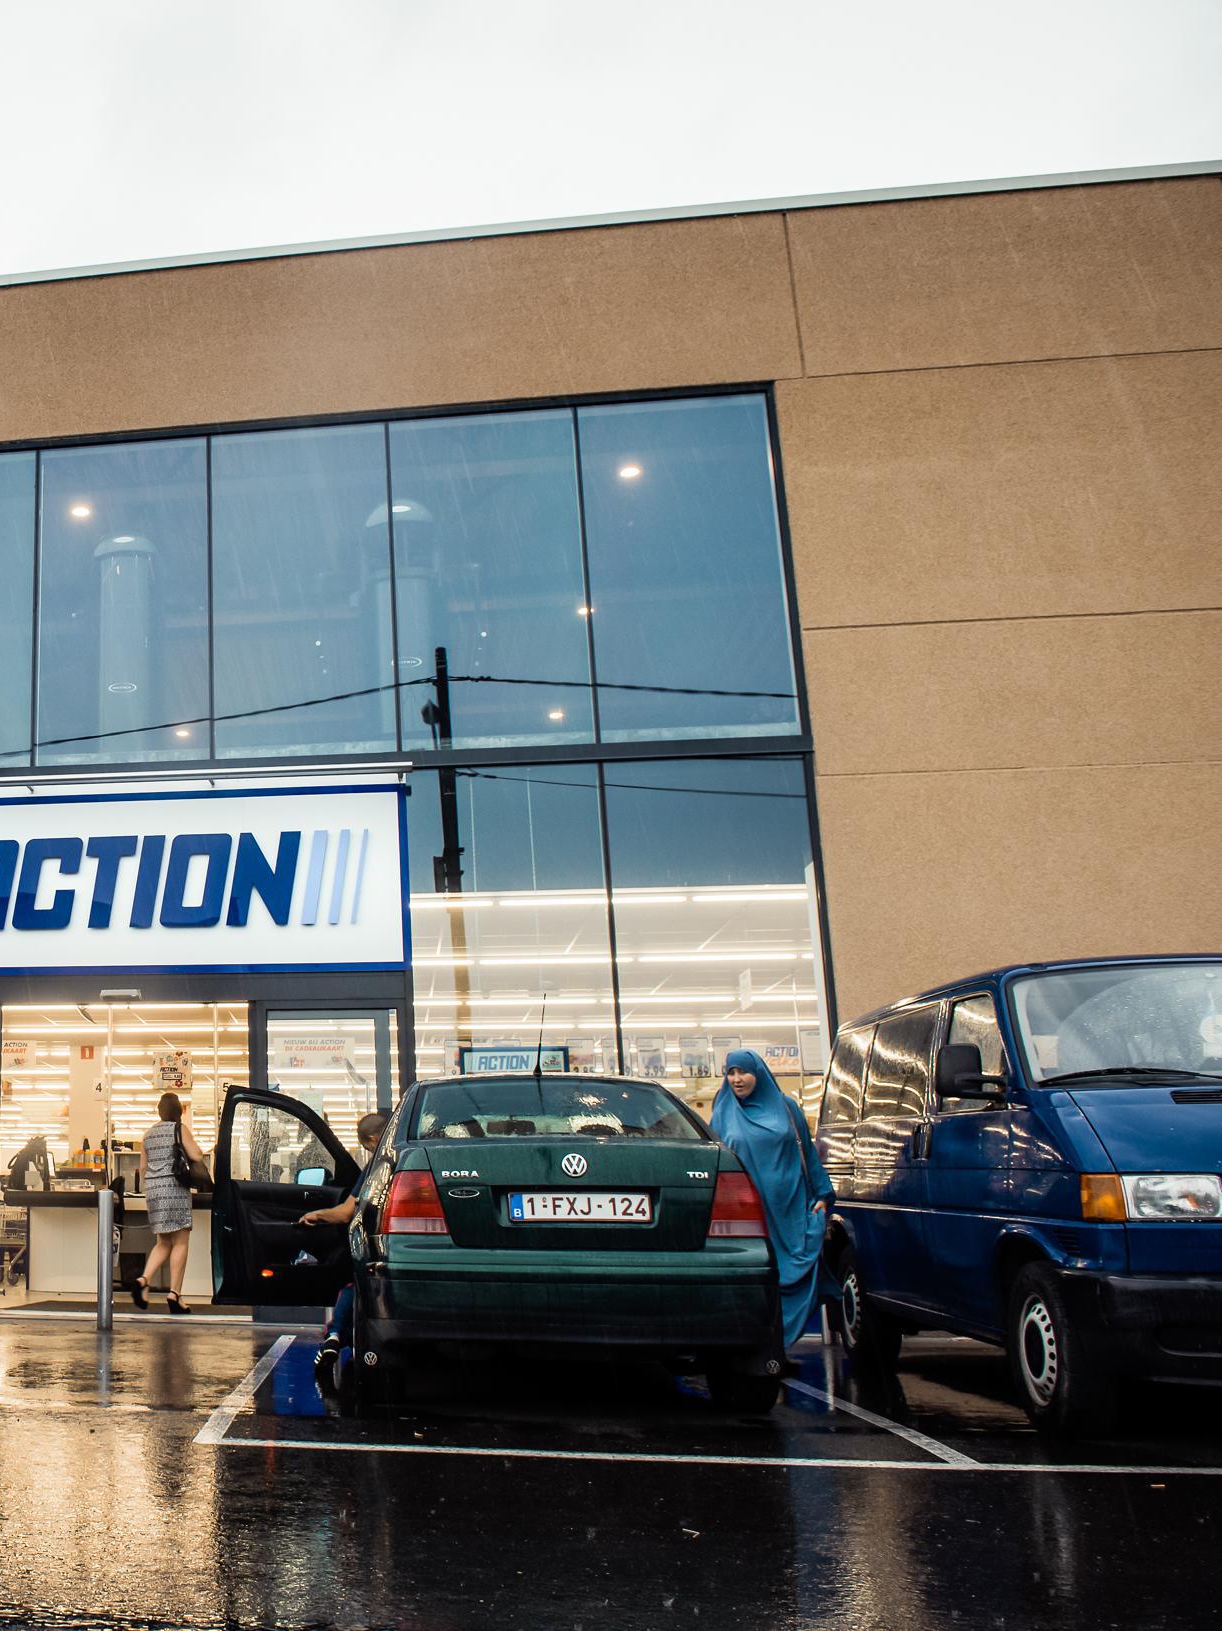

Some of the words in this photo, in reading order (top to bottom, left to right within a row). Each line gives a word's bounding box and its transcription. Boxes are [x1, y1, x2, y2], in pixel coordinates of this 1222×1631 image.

[478, 1055, 530, 1071] ACTION
[95, 1083, 103, 1092] 4
[223, 1082, 229, 1092] 5
[441, 1170, 480, 1178] BORA
[686, 1171, 709, 1179] TDI
[514, 1208, 522, 1217] B
